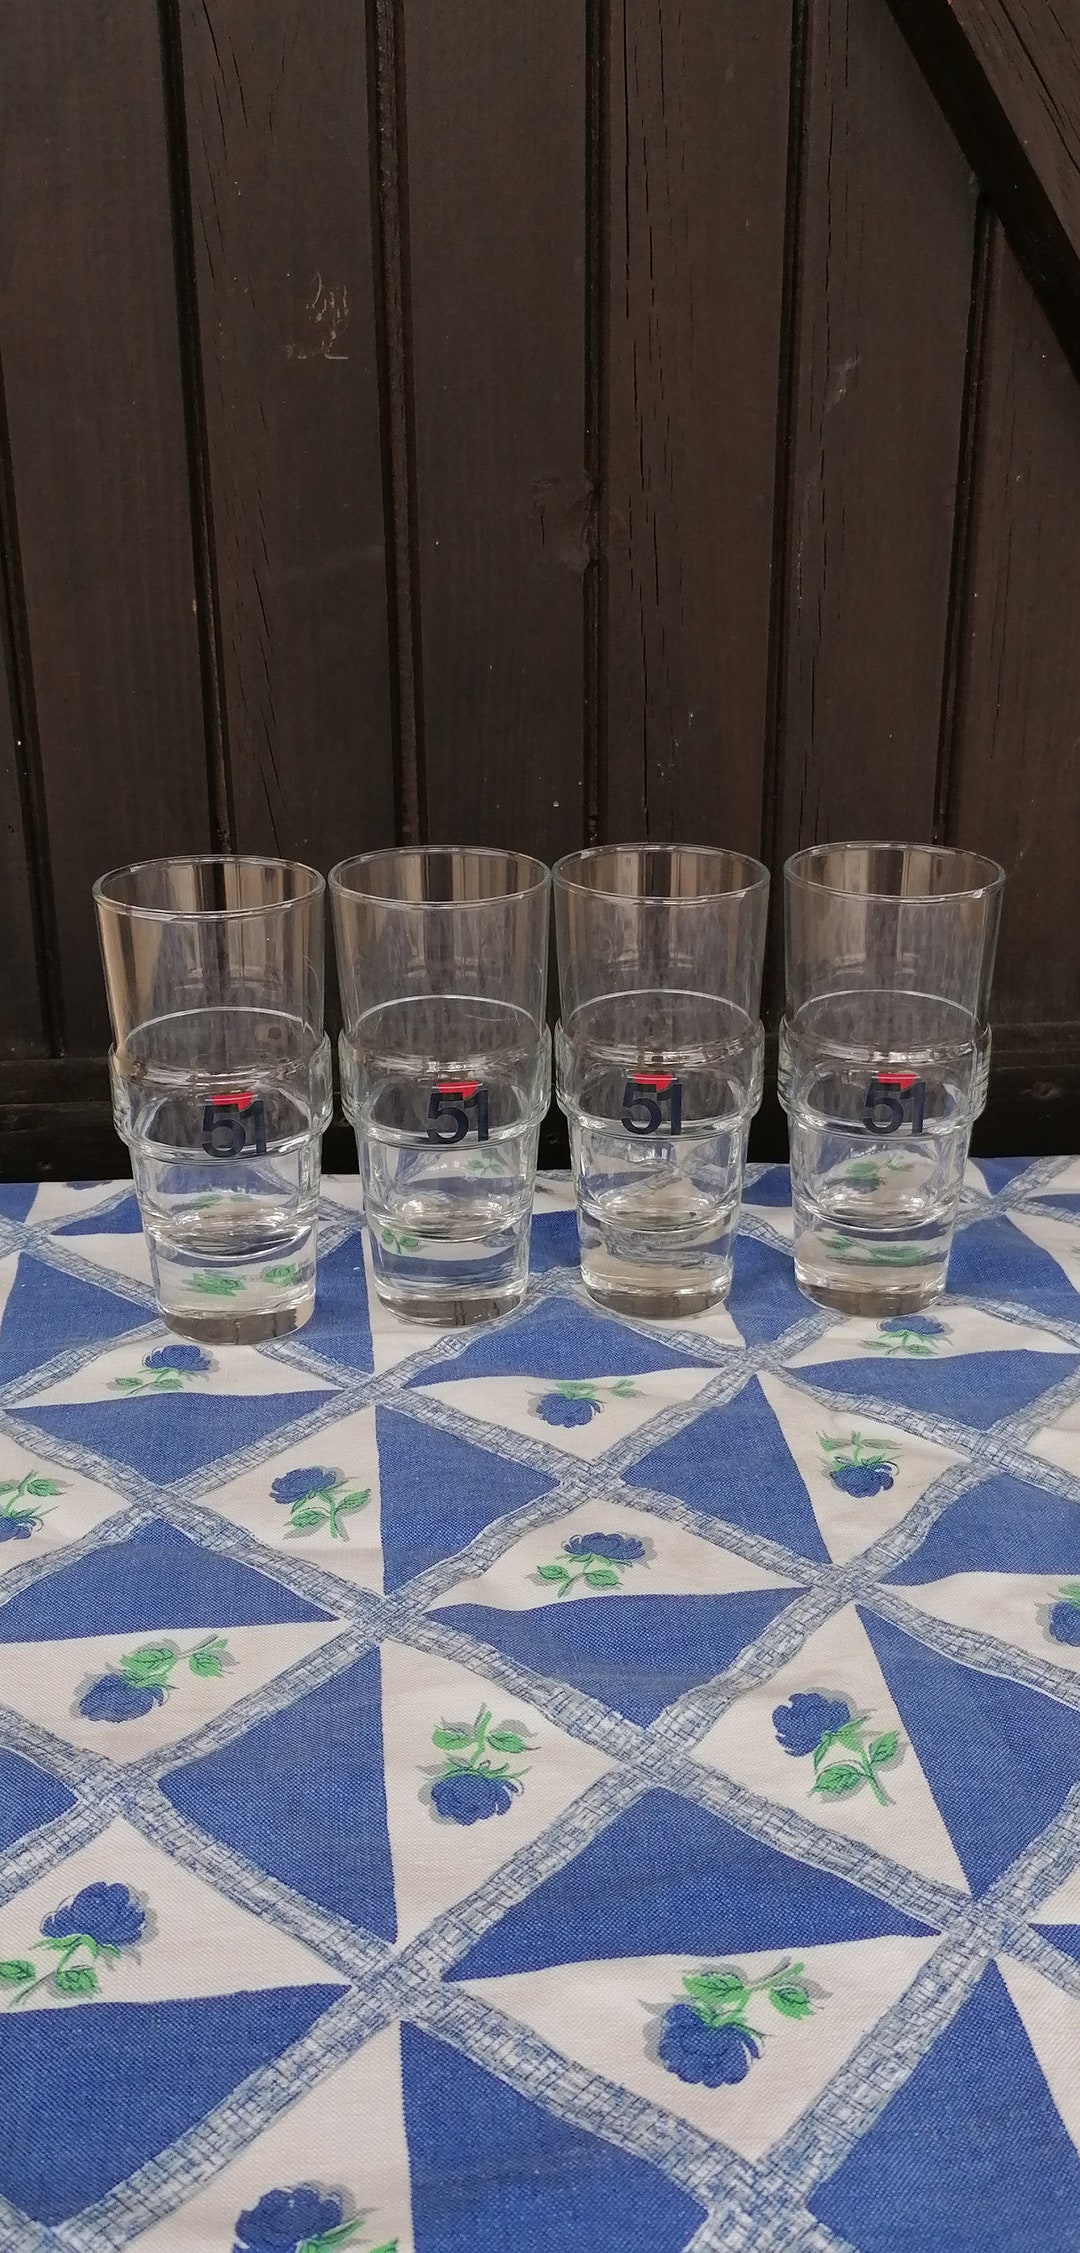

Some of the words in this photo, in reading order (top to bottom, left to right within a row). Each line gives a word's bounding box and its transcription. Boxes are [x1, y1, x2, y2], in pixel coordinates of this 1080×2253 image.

[201, 1099, 267, 1158] 51
[426, 1089, 489, 1144] 51
[621, 1082, 682, 1136] 51
[862, 1082, 926, 1135] 51
